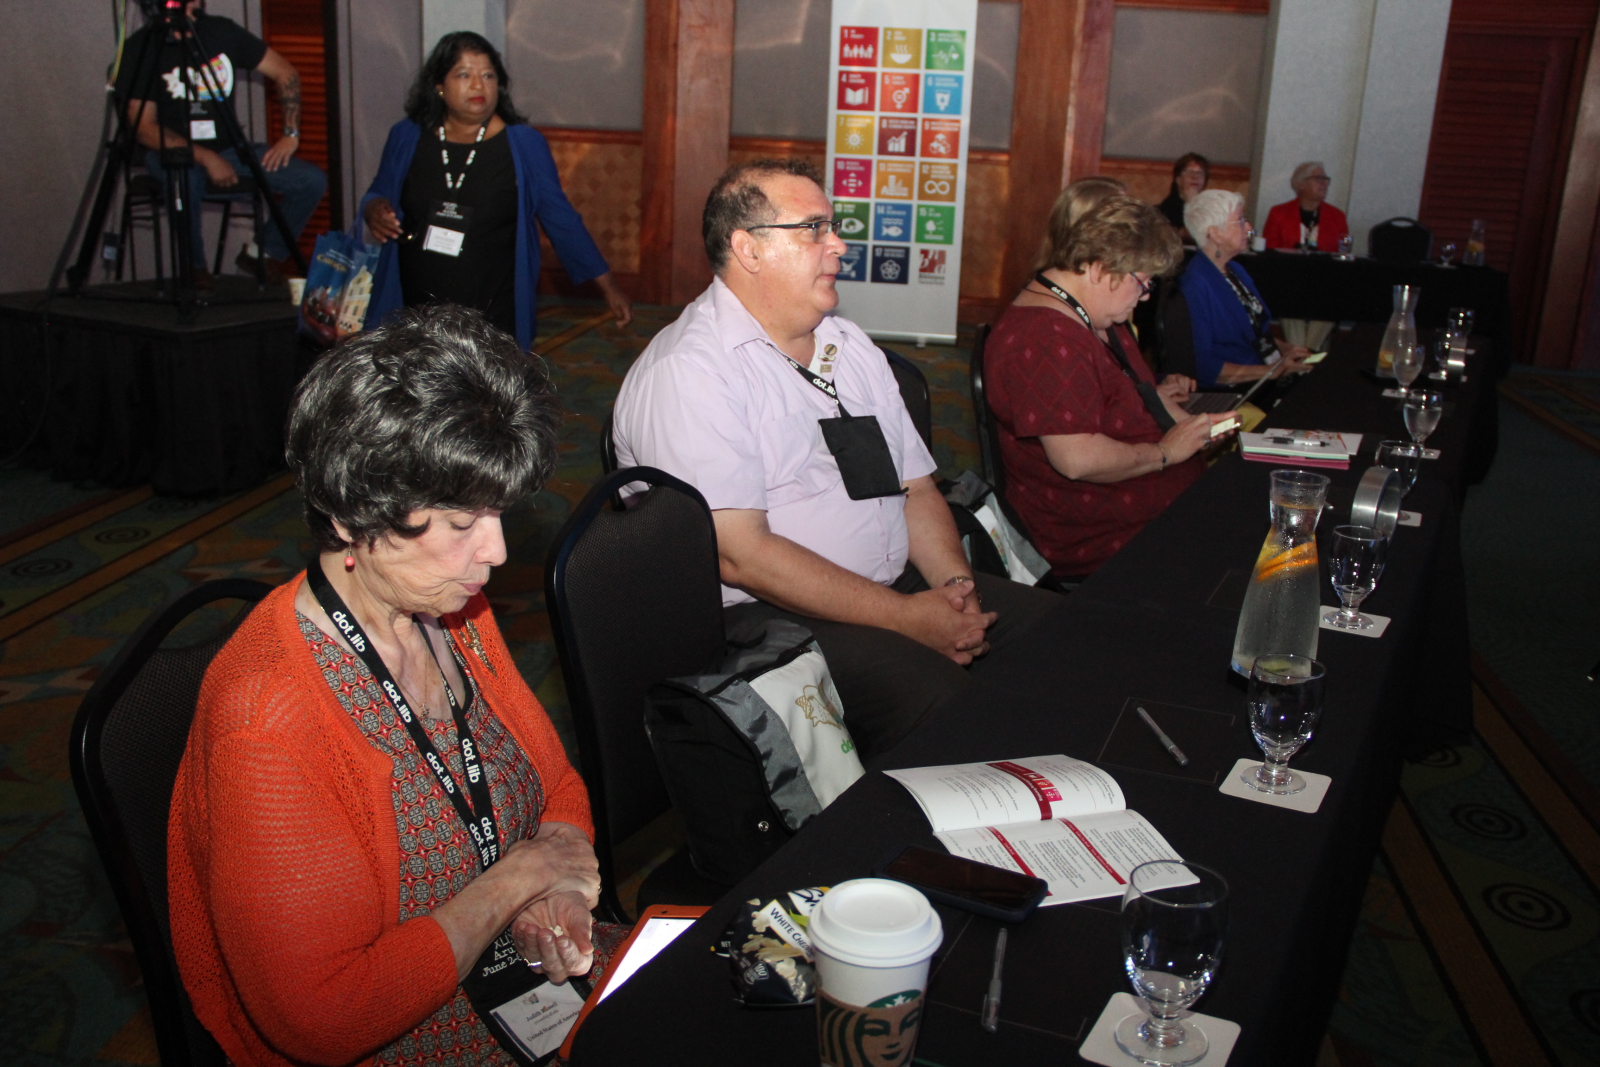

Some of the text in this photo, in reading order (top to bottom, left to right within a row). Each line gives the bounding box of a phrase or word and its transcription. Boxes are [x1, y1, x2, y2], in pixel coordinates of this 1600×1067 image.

[812, 378, 836, 396] dot.lib
[332, 610, 366, 652] dot.lib
[383, 680, 412, 723] dot.lib
[426, 752, 454, 794] dot.lib
[462, 738, 481, 784] dot.lib
[469, 823, 490, 867] dot.lib
[770, 907, 795, 935] WHITE
[494, 943, 515, 961] Aru
[482, 961, 508, 977] June
[754, 962, 768, 976] 100
[527, 1030, 544, 1042] United
[542, 1023, 558, 1033] States
